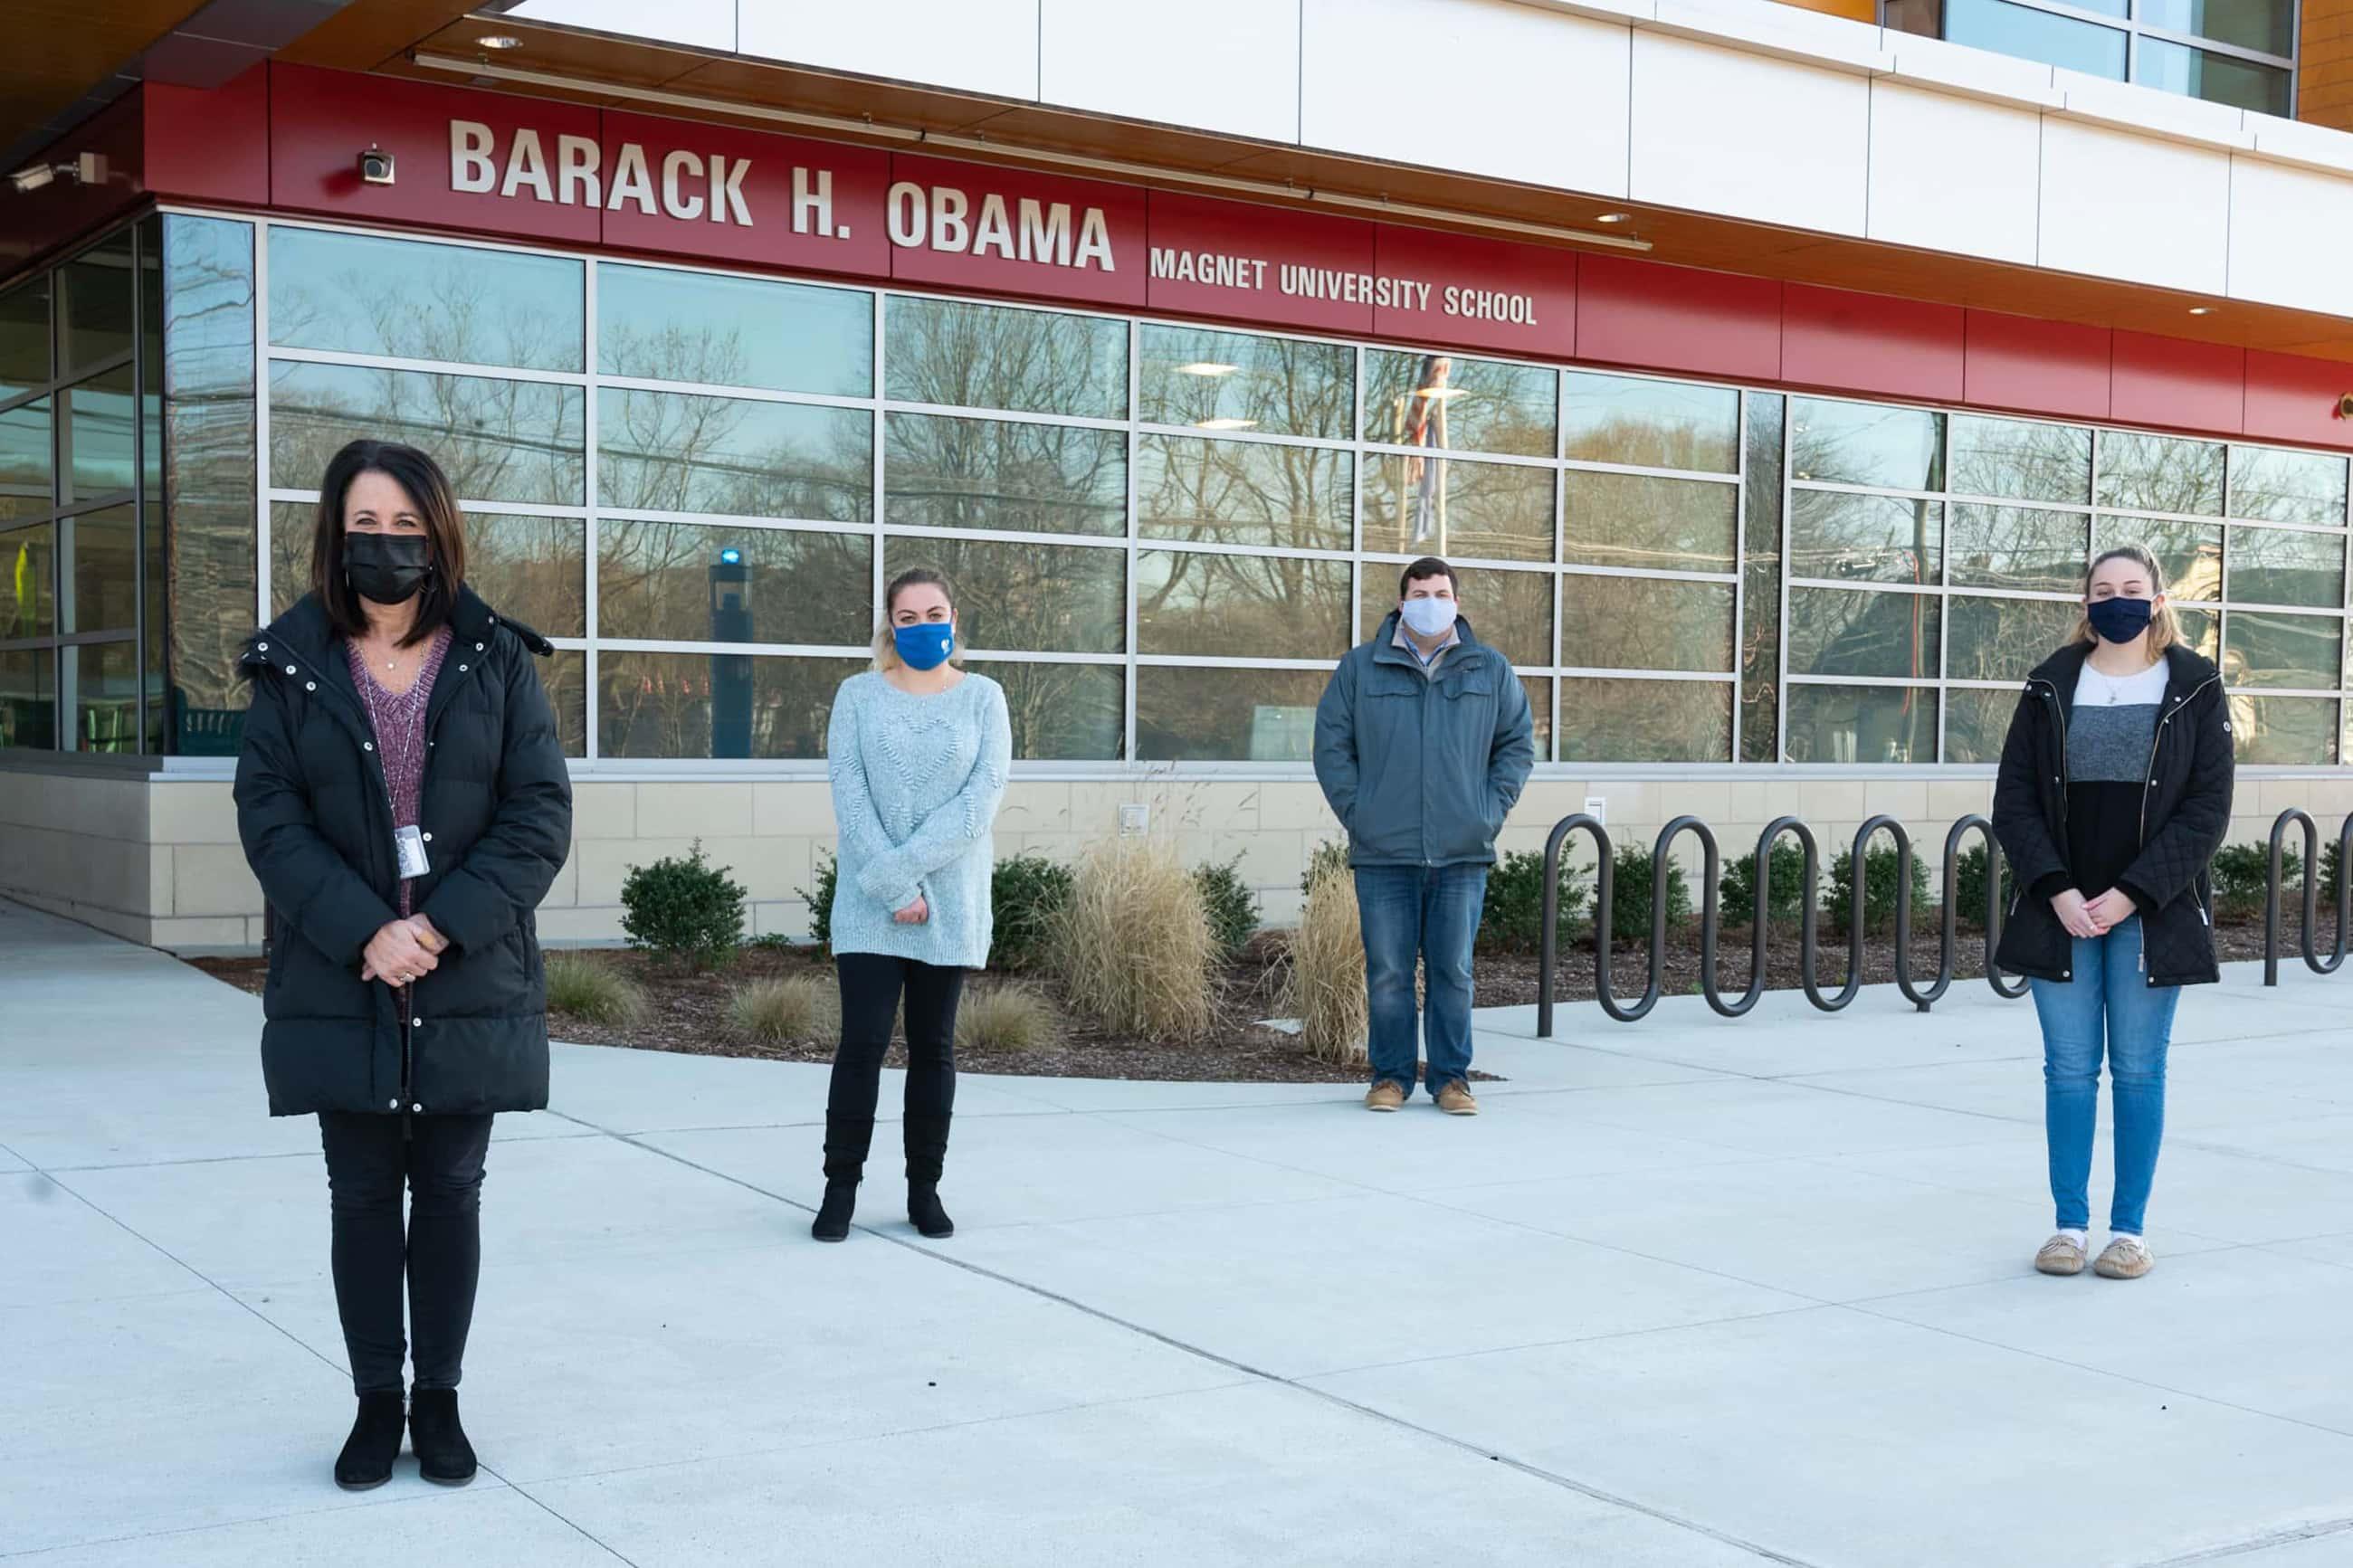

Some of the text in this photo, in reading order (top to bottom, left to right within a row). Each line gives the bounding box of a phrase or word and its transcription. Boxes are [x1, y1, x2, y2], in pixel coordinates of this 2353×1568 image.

[450, 119, 1538, 326] BARACK H. OBAMA MAGNET UNIVERSITY SCHOOL
